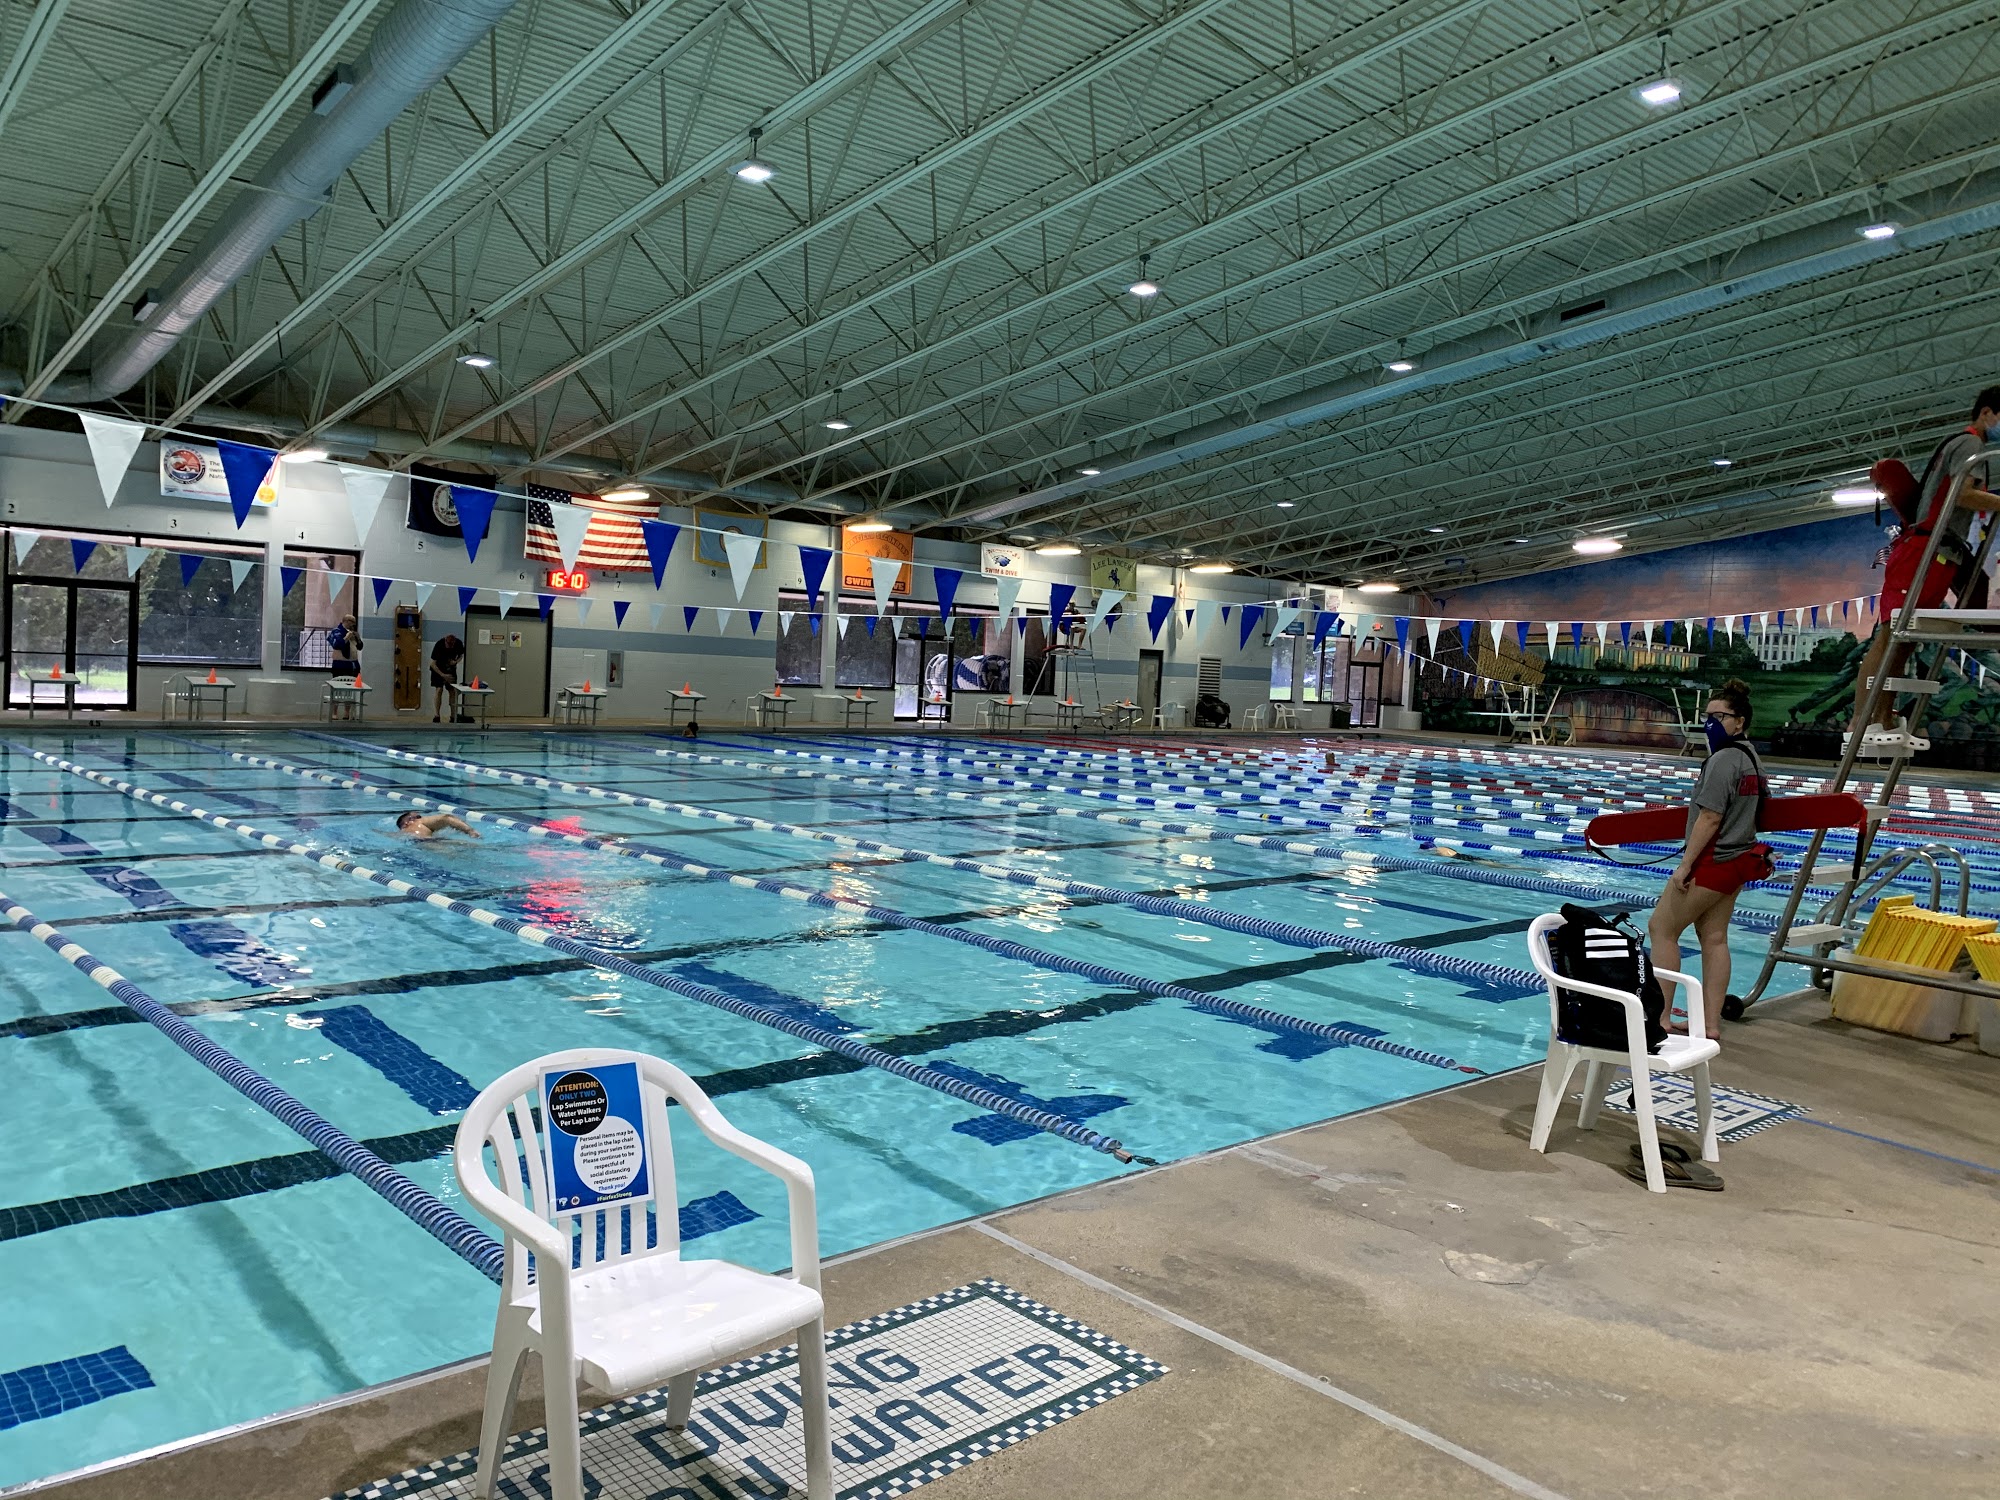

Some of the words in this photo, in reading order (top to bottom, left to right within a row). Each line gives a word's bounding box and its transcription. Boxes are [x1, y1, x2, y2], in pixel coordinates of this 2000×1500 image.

[8, 503, 14, 513] 2
[170, 518, 177, 528] 3
[298, 531, 304, 540] 4
[417, 541, 424, 549] 5
[519, 572, 525, 580] 6
[551, 572, 583, 589] 16:10
[846, 576, 871, 587] SWIM
[1638, 954, 1646, 984] adidas
[555, 1081, 599, 1093] ATTENTION:
[559, 1092, 578, 1100] ONLY
[579, 1090, 597, 1098] TWO
[564, 1099, 597, 1109] Swimmers
[558, 1110, 577, 1118] Water
[577, 1107, 601, 1116] Walkers
[571, 1118, 584, 1126] Lap
[579, 1134, 601, 1142] Personal
[580, 1142, 598, 1150] placed
[594, 1160, 619, 1170] respectful
[604, 1167, 631, 1176] distancing
[826, 1343, 1093, 1465] WATER
